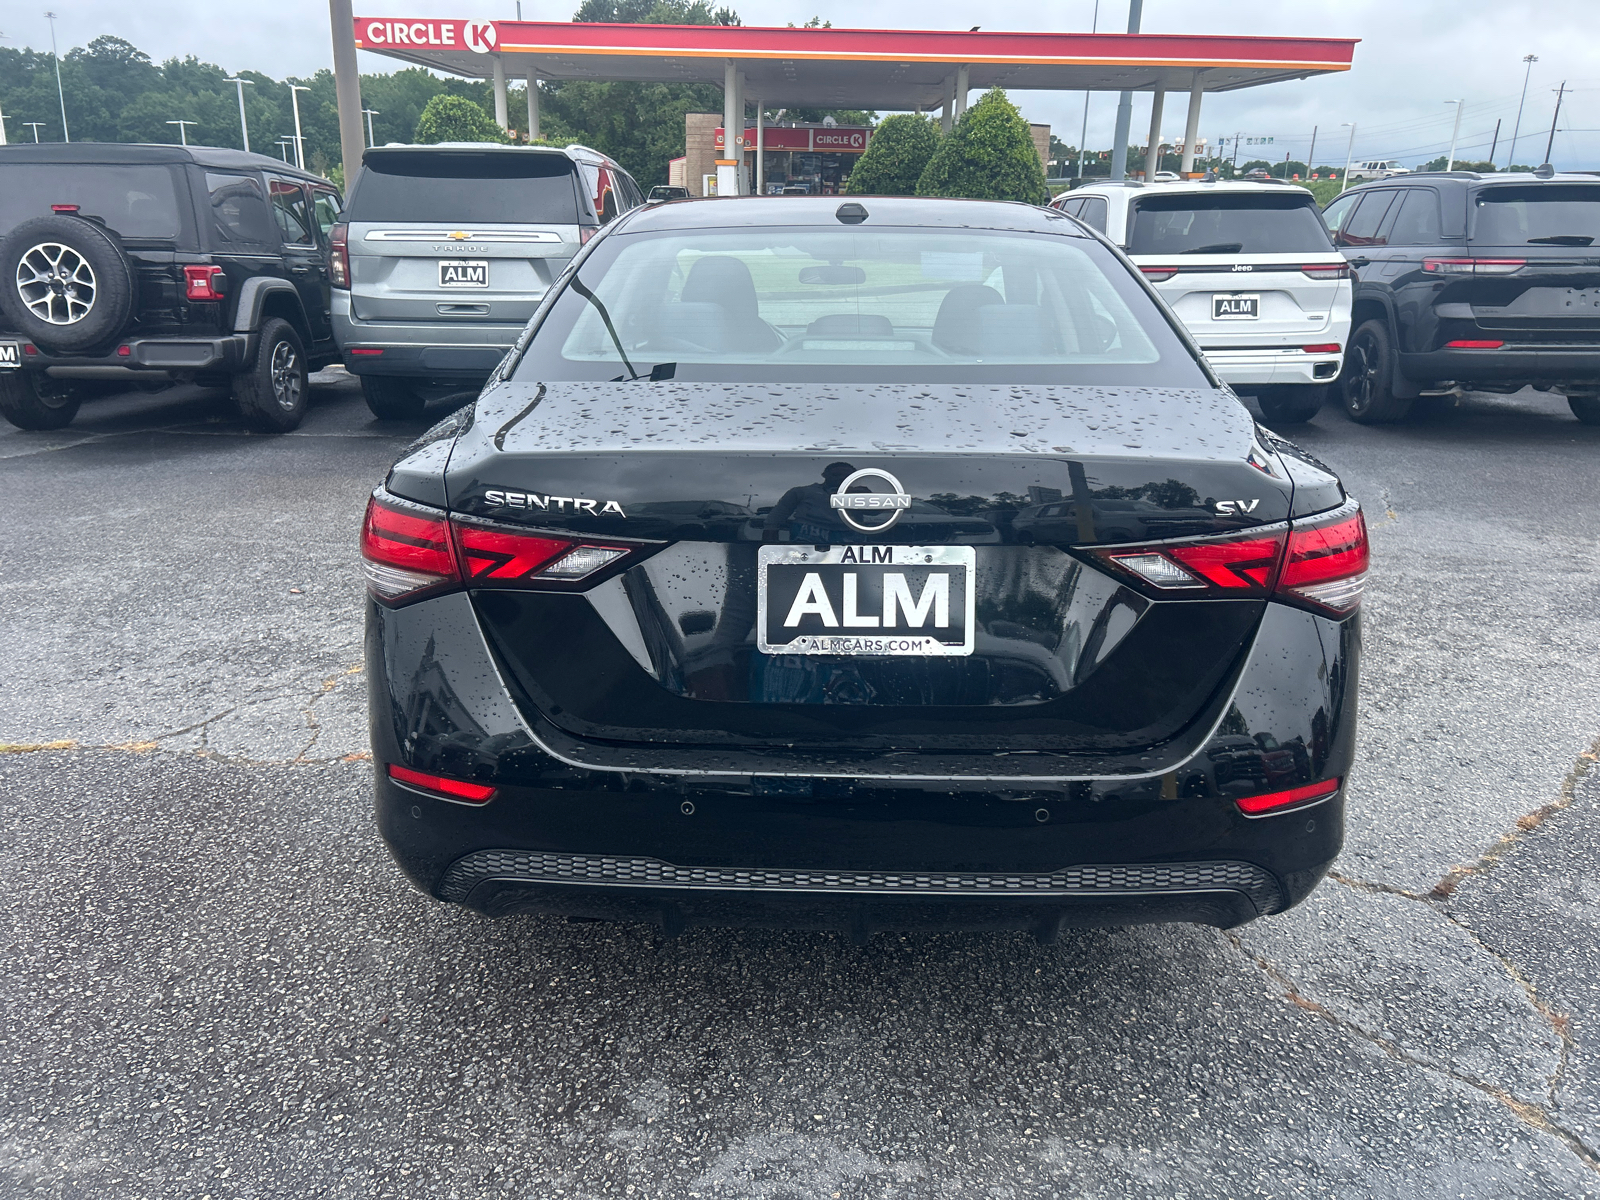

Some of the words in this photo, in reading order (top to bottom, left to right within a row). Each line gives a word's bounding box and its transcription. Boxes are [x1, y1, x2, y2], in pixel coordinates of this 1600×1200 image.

[366, 21, 456, 46] CIRCLE
[471, 24, 495, 51] K
[816, 135, 849, 145] CIRCLE
[444, 267, 483, 281] ALM
[1231, 264, 1253, 272] Jeep
[1219, 300, 1251, 313] ALM
[484, 490, 627, 519] SENTRA
[832, 497, 910, 507] NISSAN
[1215, 498, 1260, 518] SV
[840, 546, 893, 564] ALM
[783, 572, 950, 629] ALM
[809, 639, 923, 652] ALMCARS.COM
